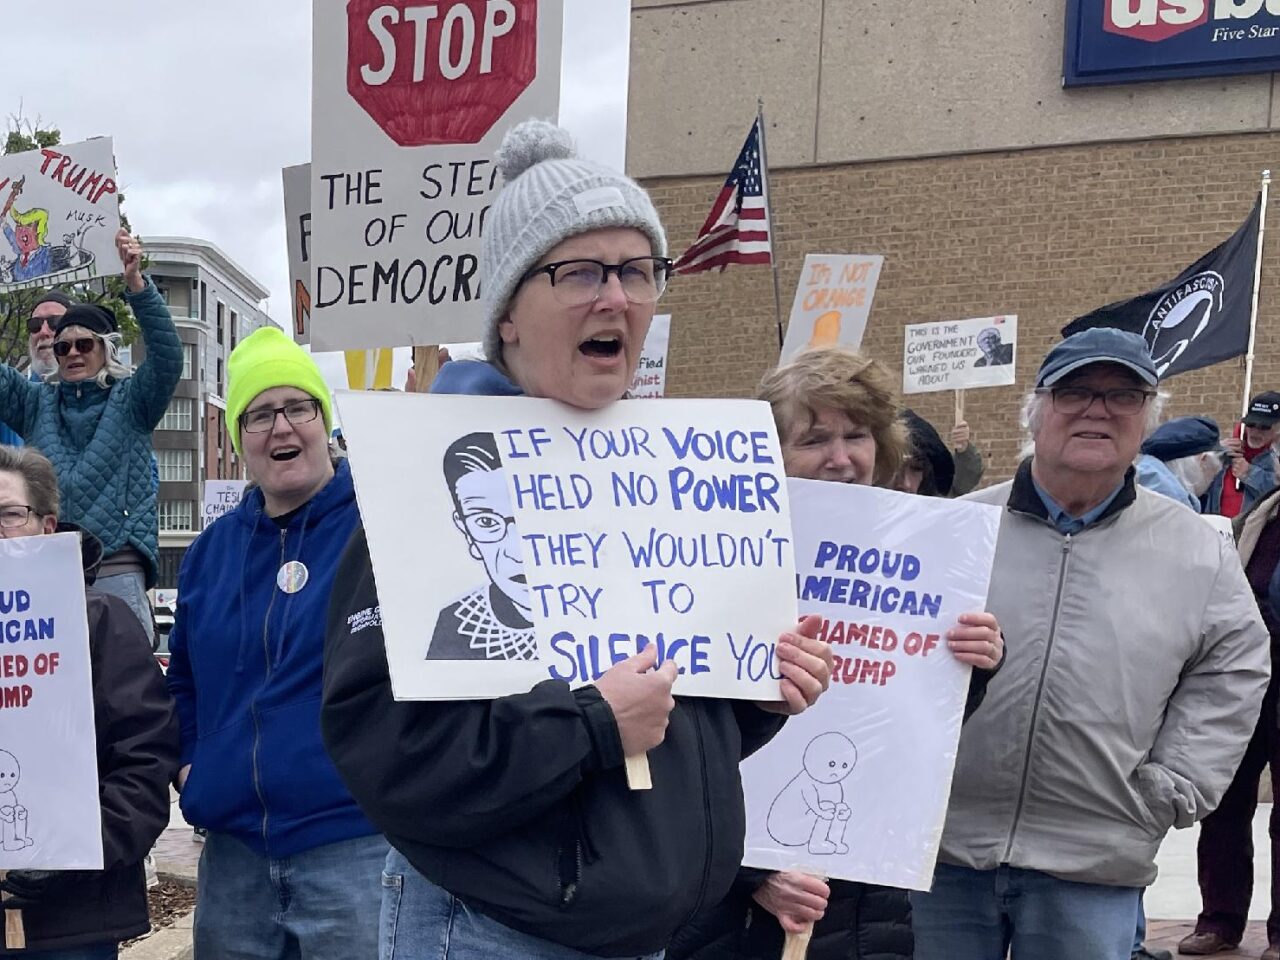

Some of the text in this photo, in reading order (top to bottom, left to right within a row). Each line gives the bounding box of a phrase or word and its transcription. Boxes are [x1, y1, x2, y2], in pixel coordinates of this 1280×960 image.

[361, 0, 516, 86] STOP
[1211, 24, 1279, 42] Five Star
[40, 149, 116, 204] TRUMP
[321, 168, 383, 210] THE
[66, 210, 106, 227] MUSK
[364, 213, 407, 247] OF
[315, 254, 481, 309] DEMOCR
[1152, 277, 1219, 330] ANTIFASCIST
[907, 335, 976, 354] GOVERNMENT
[910, 324, 959, 338] THIS IS THE
[951, 360, 966, 370] US
[501, 426, 775, 465] IF YOUR VOICE
[514, 466, 781, 514] HELD NO POWER
[523, 527, 790, 570] THEY WOULDN'T
[814, 541, 920, 581] PROUD
[533, 579, 695, 619] TRY TO
[796, 573, 943, 619] MERICAN
[798, 615, 940, 656] HAMED OF
[33, 652, 60, 676] OF
[830, 655, 896, 686] RUMP
